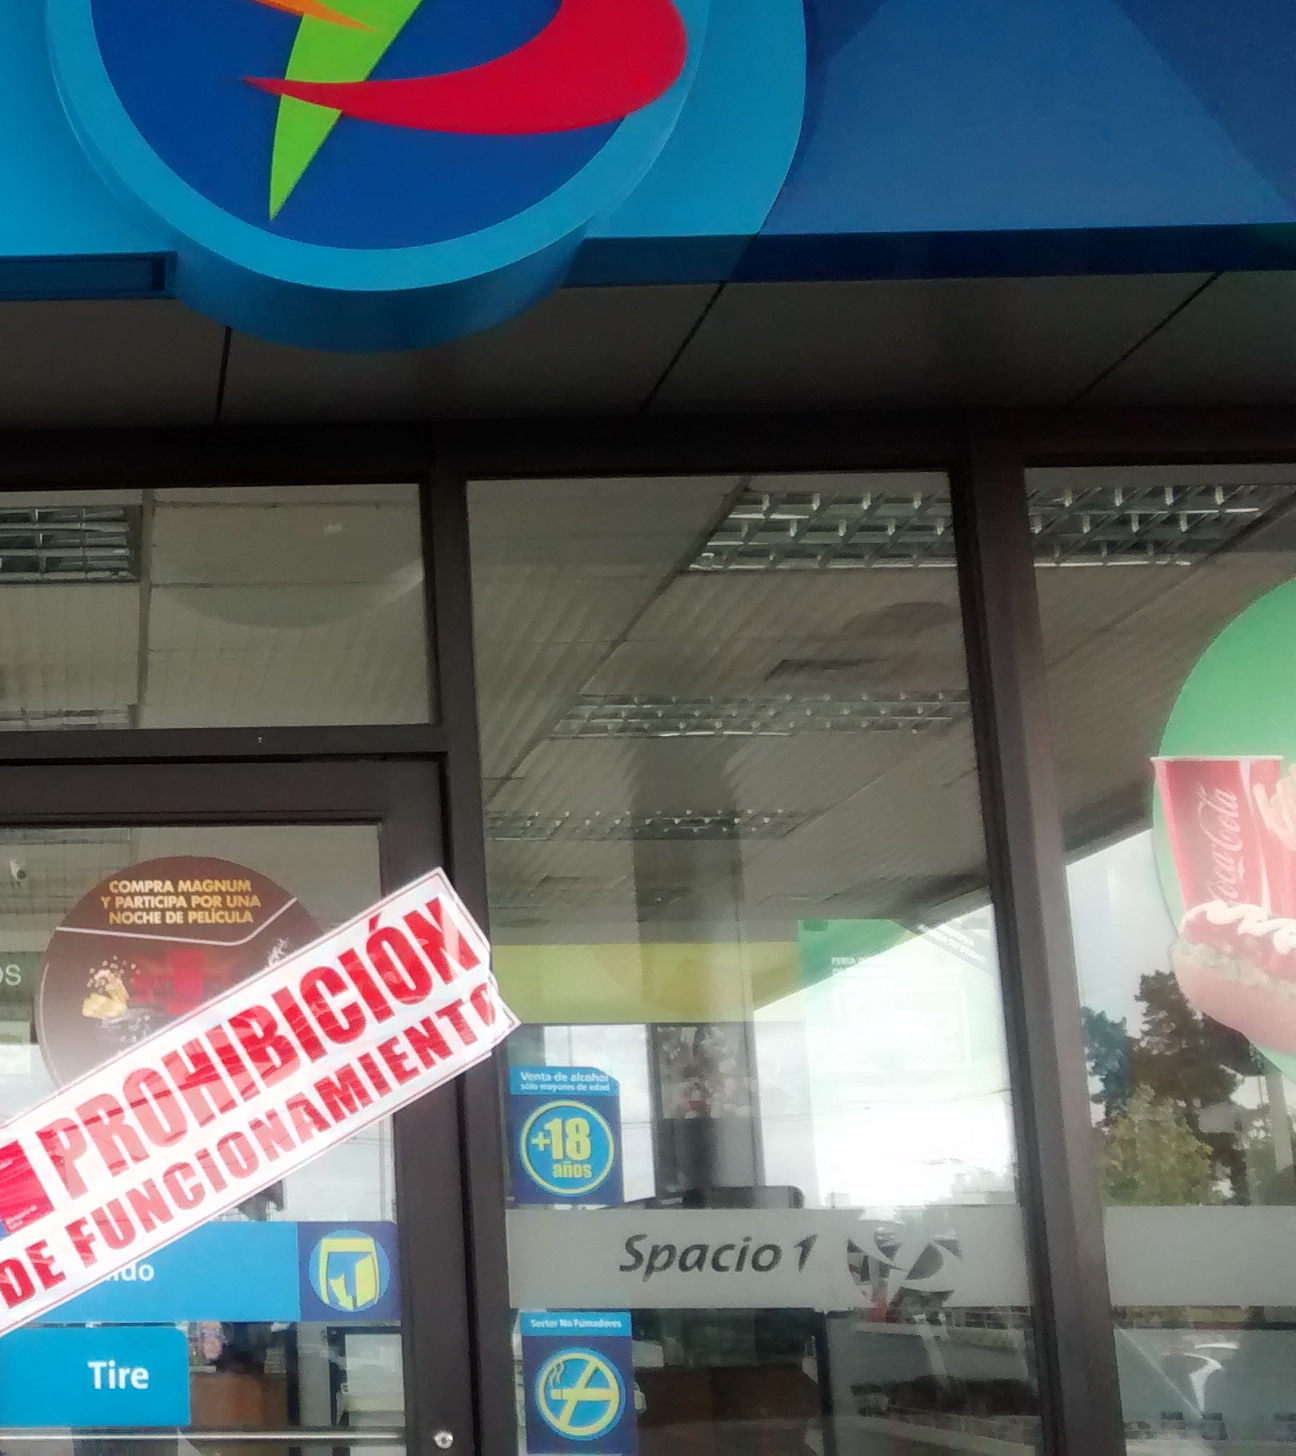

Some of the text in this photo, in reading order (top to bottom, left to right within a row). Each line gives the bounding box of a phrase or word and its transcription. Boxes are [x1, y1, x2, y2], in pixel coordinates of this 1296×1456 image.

[109, 879, 252, 893] COMPRA MAGNUM
[100, 895, 262, 908] Y PARTICIPA POR UNA
[109, 908, 254, 924] NOCHE DE PELÍCULA
[34, 897, 481, 1201] PROHIBICIÓN
[520, 1071, 610, 1082] Venta de alcohol
[520, 1082, 611, 1092] sólo mayores de edad
[65, 982, 498, 1269] FUNCIONAMIENTO
[531, 1117, 592, 1160] +18
[552, 1160, 592, 1179] años
[618, 1233, 818, 1283] Spacio 1
[530, 1318, 622, 1329] Sector No Fumadores
[88, 1359, 149, 1390] Tire
